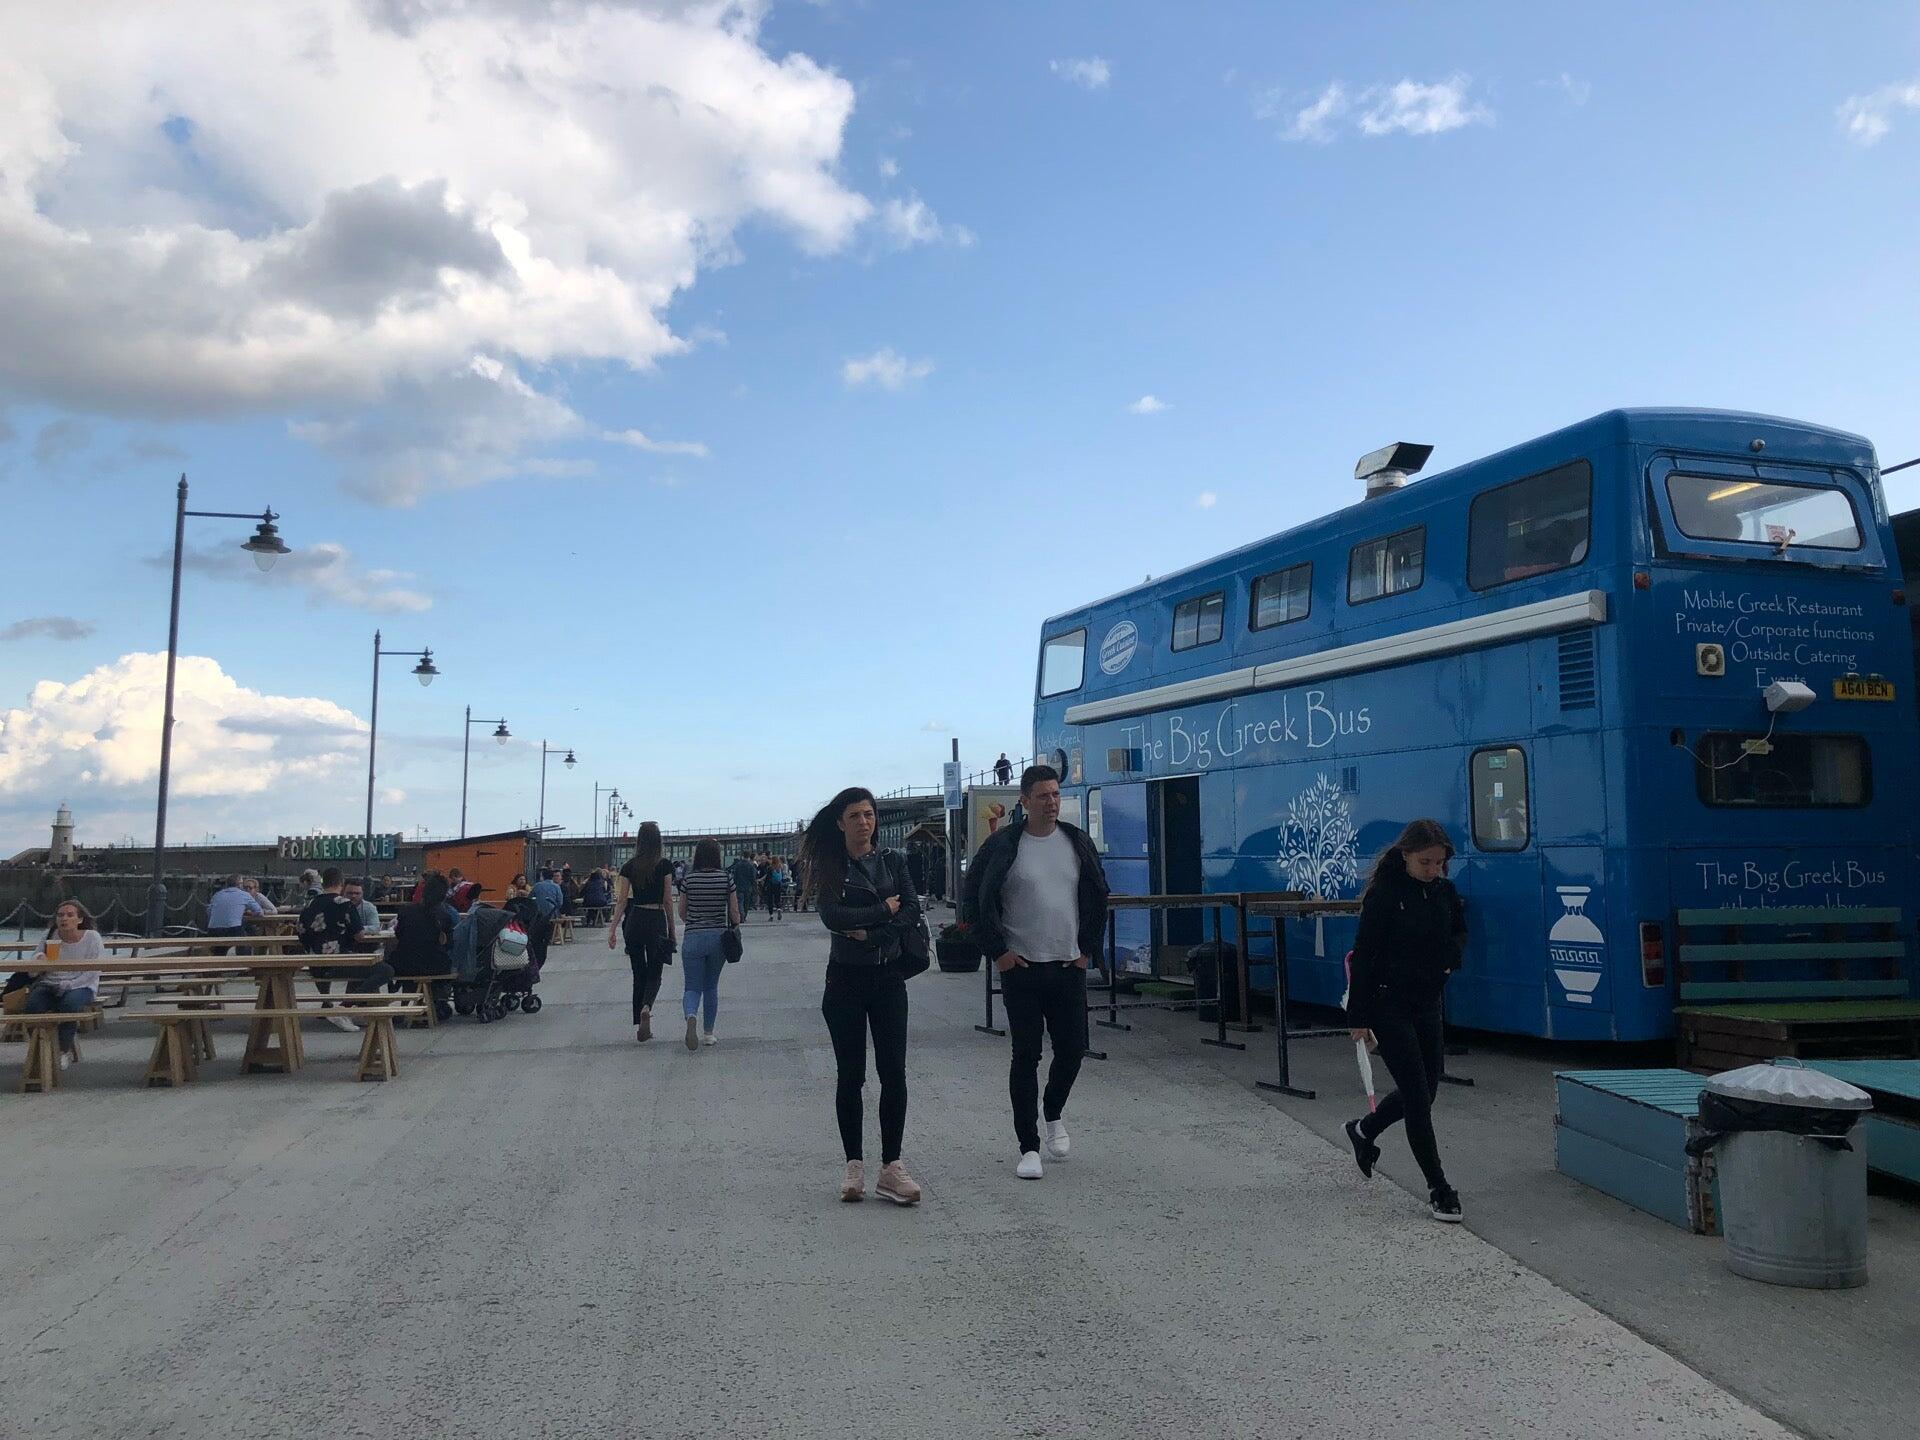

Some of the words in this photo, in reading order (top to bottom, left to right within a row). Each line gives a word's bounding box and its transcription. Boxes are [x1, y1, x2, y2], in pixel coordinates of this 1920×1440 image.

[1684, 589, 1735, 610] Mobile
[1738, 593, 1784, 613] Greek
[1787, 597, 1863, 616] Restaurant
[1676, 612, 1811, 643] Private/Corporate
[1813, 620, 1875, 641] functions
[1731, 641, 1791, 663] Outside
[1794, 644, 1857, 670] Catering
[1867, 683, 1888, 698] BCN
[1121, 722, 1163, 762] The
[1169, 716, 1211, 769] Big
[1216, 695, 1298, 757] Greek
[1306, 690, 1371, 749] Bus
[279, 840, 389, 858] FOLKESTONE
[1696, 860, 1738, 889] The
[1743, 861, 1780, 893] Big
[1783, 860, 1842, 888] Greek
[1846, 861, 1885, 888] Bus
